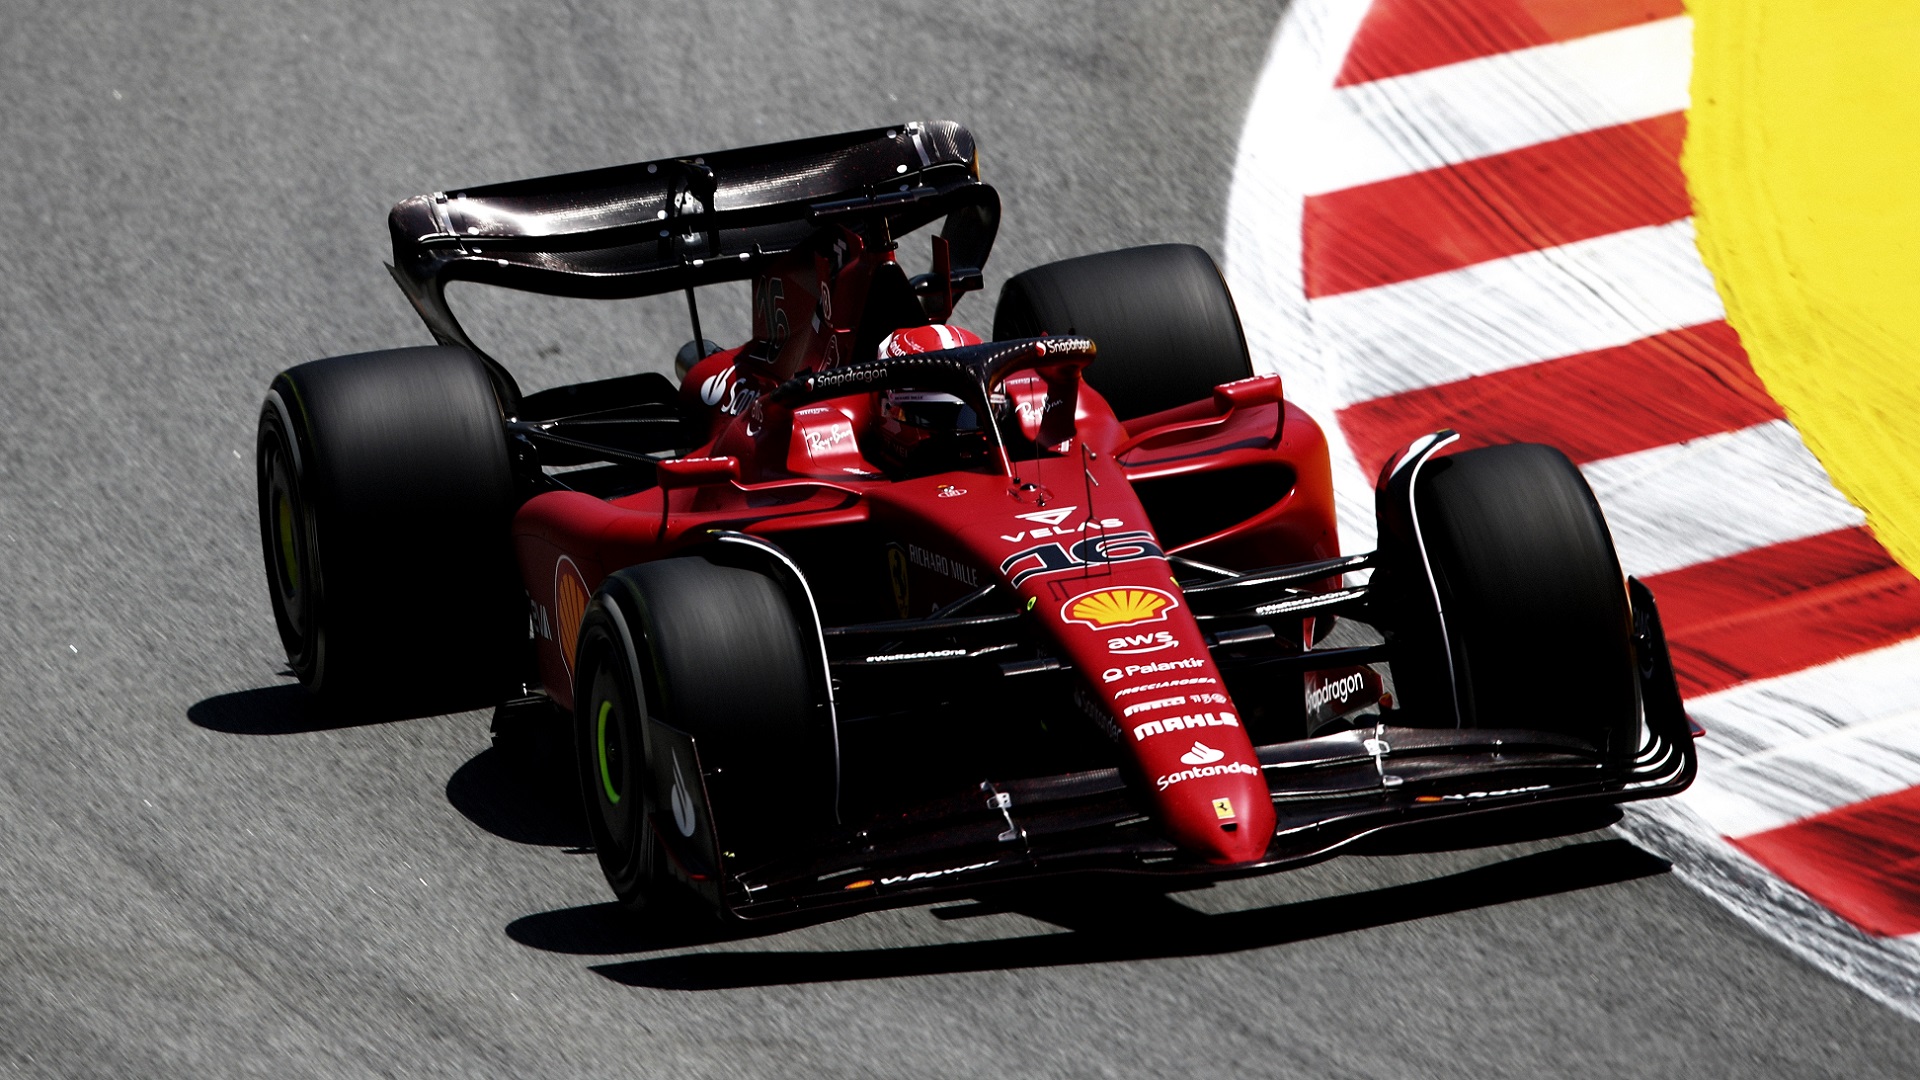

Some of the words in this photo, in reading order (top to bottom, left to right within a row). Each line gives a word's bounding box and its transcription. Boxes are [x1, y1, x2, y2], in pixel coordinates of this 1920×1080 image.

[817, 366, 889, 388] Snapdragon
[1000, 518, 1124, 543] VELAS
[908, 542, 949, 577] RICHARD
[999, 530, 1168, 590] 16
[1107, 631, 1174, 650] aws
[1125, 657, 1206, 677] Palantir
[1133, 712, 1239, 742] MAHLE
[1156, 761, 1259, 792] Santander
